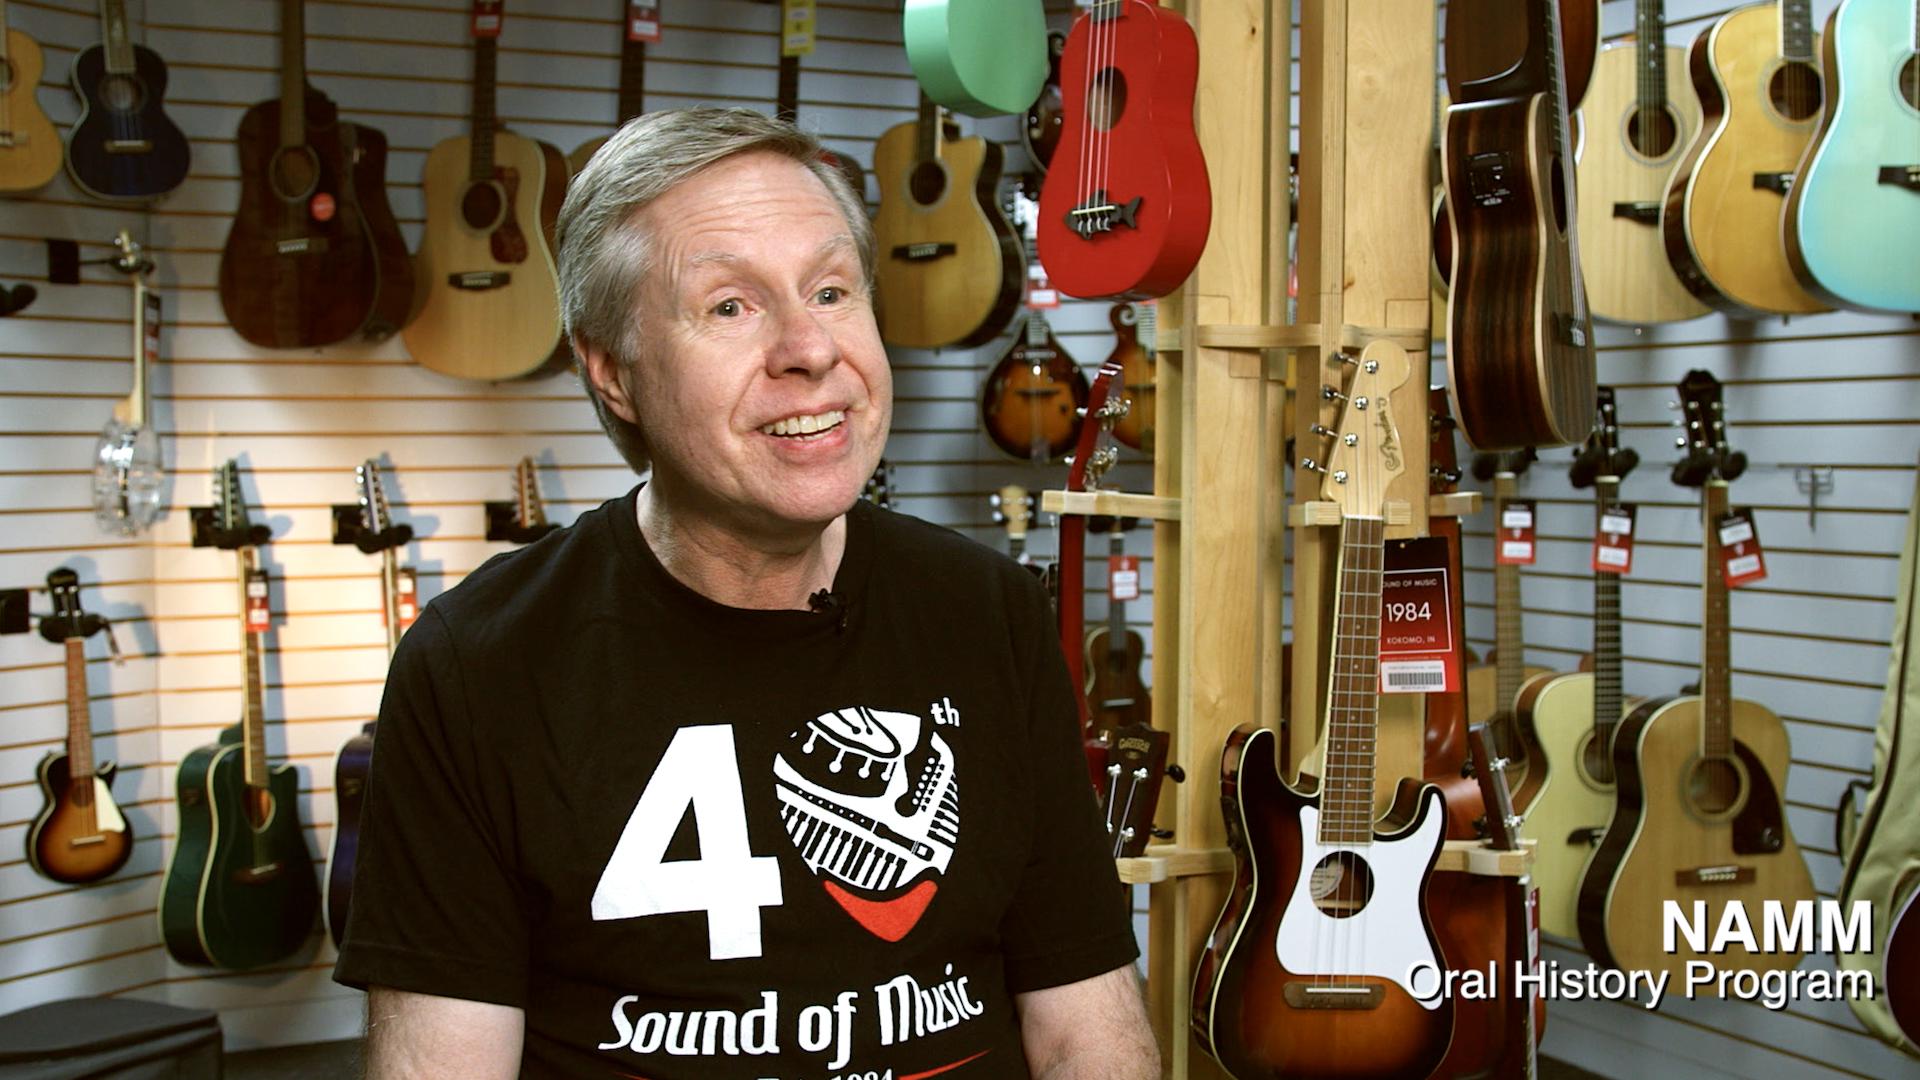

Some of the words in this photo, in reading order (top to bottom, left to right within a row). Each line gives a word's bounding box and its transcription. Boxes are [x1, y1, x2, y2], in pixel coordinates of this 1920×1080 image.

[1382, 580, 1402, 588] OUND
[1402, 579, 1413, 588] OF
[1414, 578, 1438, 587] MUSIC
[1385, 601, 1432, 622] 1984
[1427, 635, 1436, 643] IN
[598, 991, 780, 1056] Sound
[798, 991, 858, 1070] of
[874, 963, 984, 1046] Music
